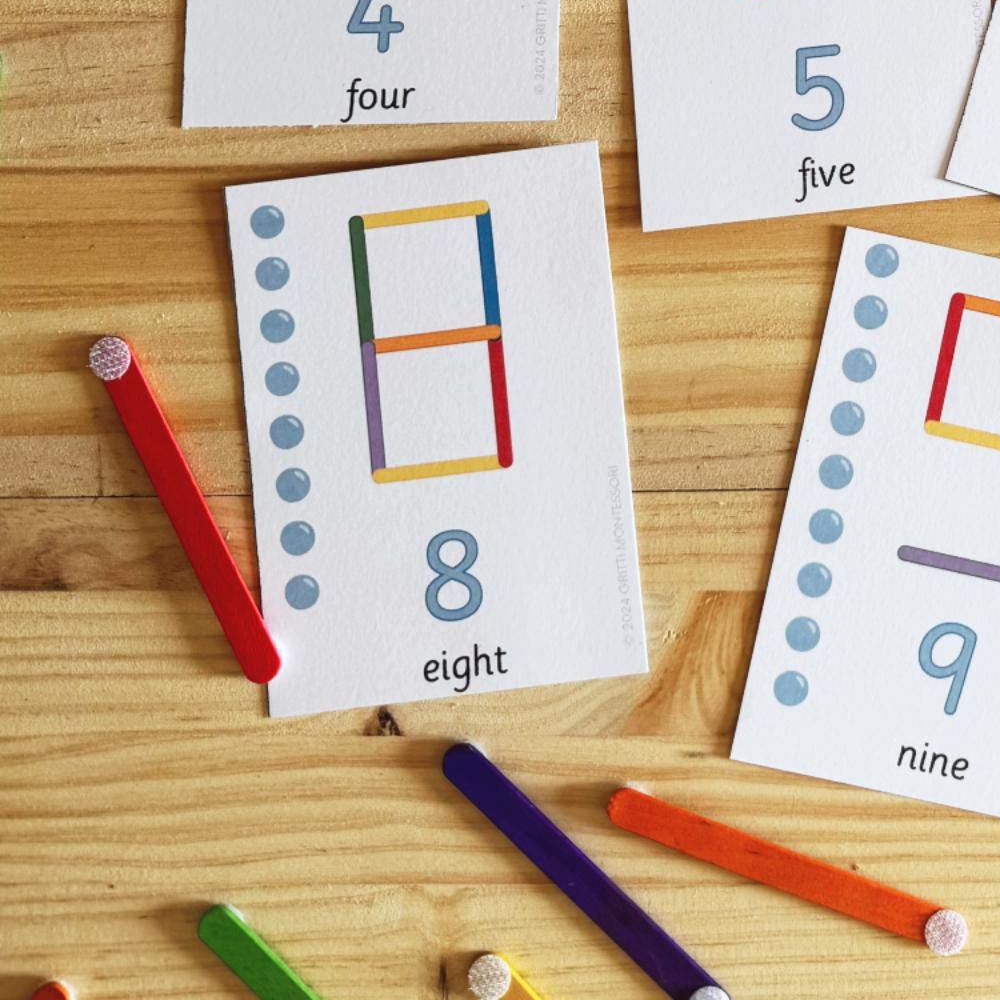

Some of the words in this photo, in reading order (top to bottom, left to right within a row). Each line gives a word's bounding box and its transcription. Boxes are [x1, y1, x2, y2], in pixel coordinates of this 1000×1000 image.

[535, 12, 548, 47] GRITTI
[534, 50, 546, 80] 2024
[340, 78, 415, 123] four
[790, 44, 845, 132] 5
[795, 157, 855, 202] five
[607, 465, 626, 552] MONTESSORI
[425, 530, 485, 622] 8
[615, 555, 632, 594] GRITTI
[620, 598, 634, 631] 2024
[423, 643, 508, 693] eight
[916, 621, 977, 717] 9
[896, 743, 969, 781] nine
